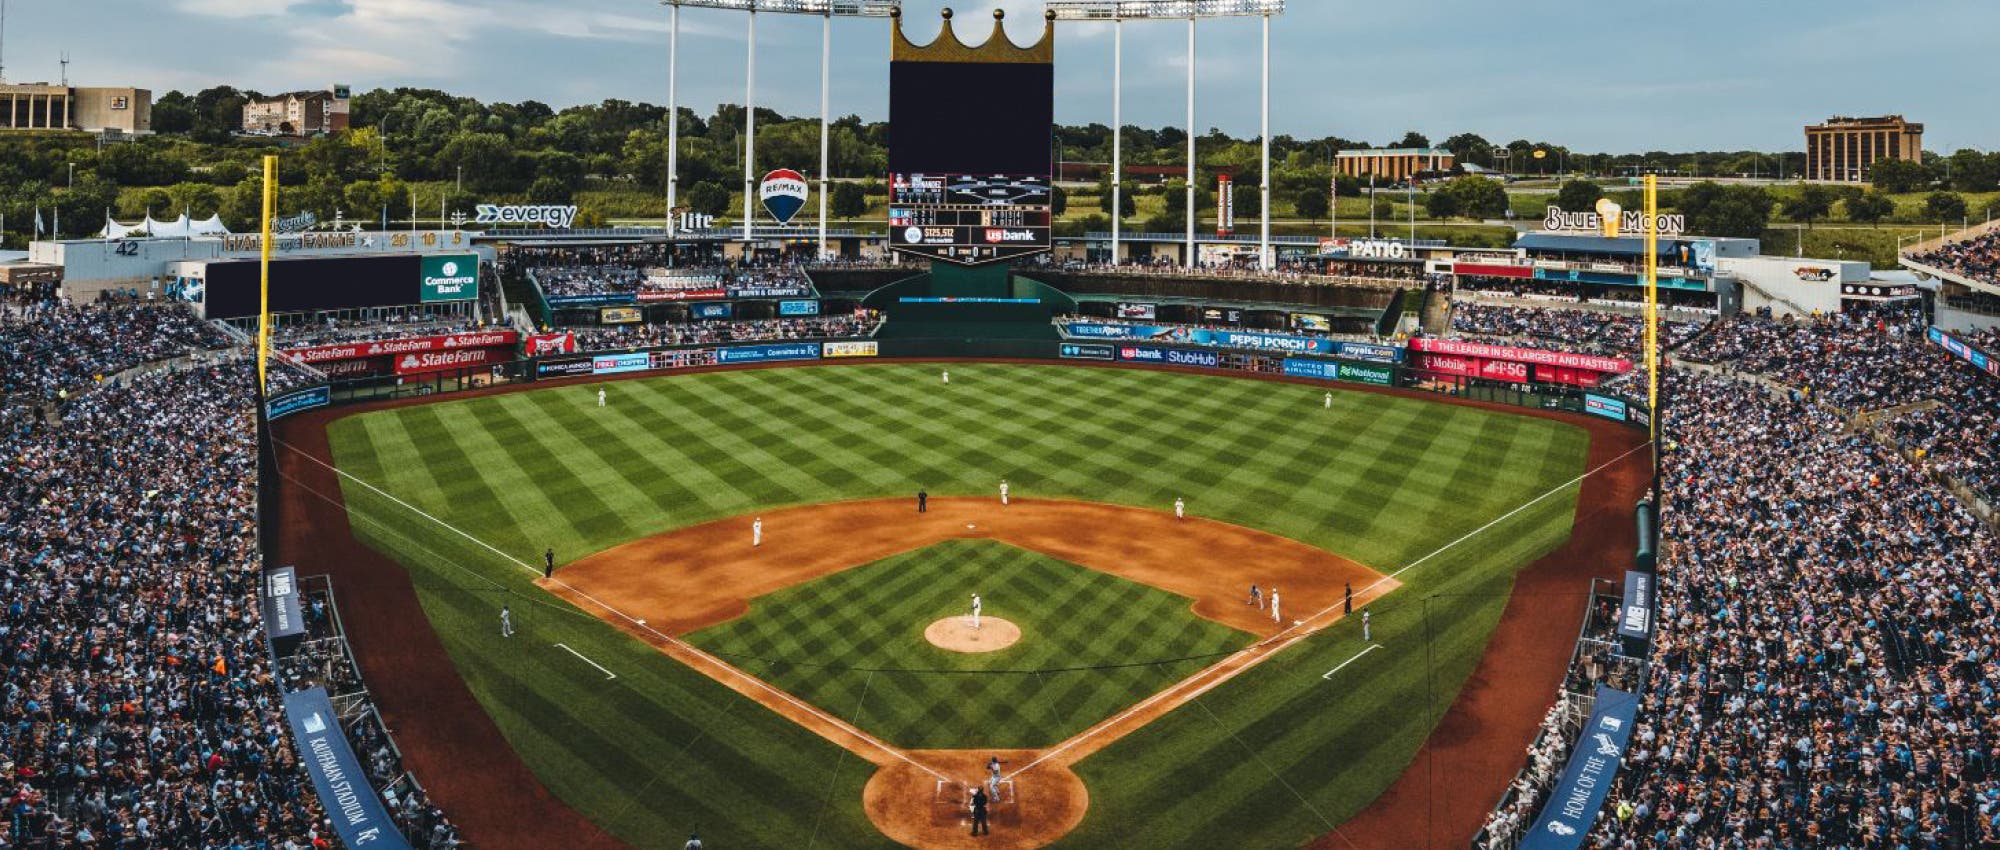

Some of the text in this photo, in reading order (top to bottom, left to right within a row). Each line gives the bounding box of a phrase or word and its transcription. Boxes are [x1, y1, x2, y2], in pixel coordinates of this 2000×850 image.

[766, 184, 802, 193] RE/MAX
[502, 205, 576, 228] evergy
[680, 212, 713, 233] Lite
[1544, 206, 1596, 231] BLUE
[302, 234, 356, 248] FAME
[391, 234, 408, 247] 20
[422, 234, 435, 246] 10
[454, 234, 461, 245] 5
[116, 242, 138, 256] 42
[1352, 241, 1403, 258] PATIO
[426, 276, 474, 287] Commerce
[438, 284, 461, 294] Bank
[1230, 334, 1305, 350] PEPSI PORCH
[1168, 351, 1216, 366] StubHub
[1345, 346, 1394, 358] royals.com
[1438, 342, 1454, 352] THE
[1456, 344, 1490, 354] LEADER
[1492, 348, 1500, 356] IN
[1518, 351, 1557, 364] LARGEST
[1559, 356, 1578, 366] AND
[1433, 356, 1466, 370] Mobile
[1508, 362, 1526, 377] 5G
[1286, 367, 1322, 376] AIRLINES
[1352, 368, 1389, 380] National
[1583, 756, 1606, 775] THE
[309, 736, 346, 782] KAUFFMAN
[330, 780, 368, 826] STADIUM
[1577, 774, 1596, 789] OF
[1562, 787, 1592, 819] HOME
